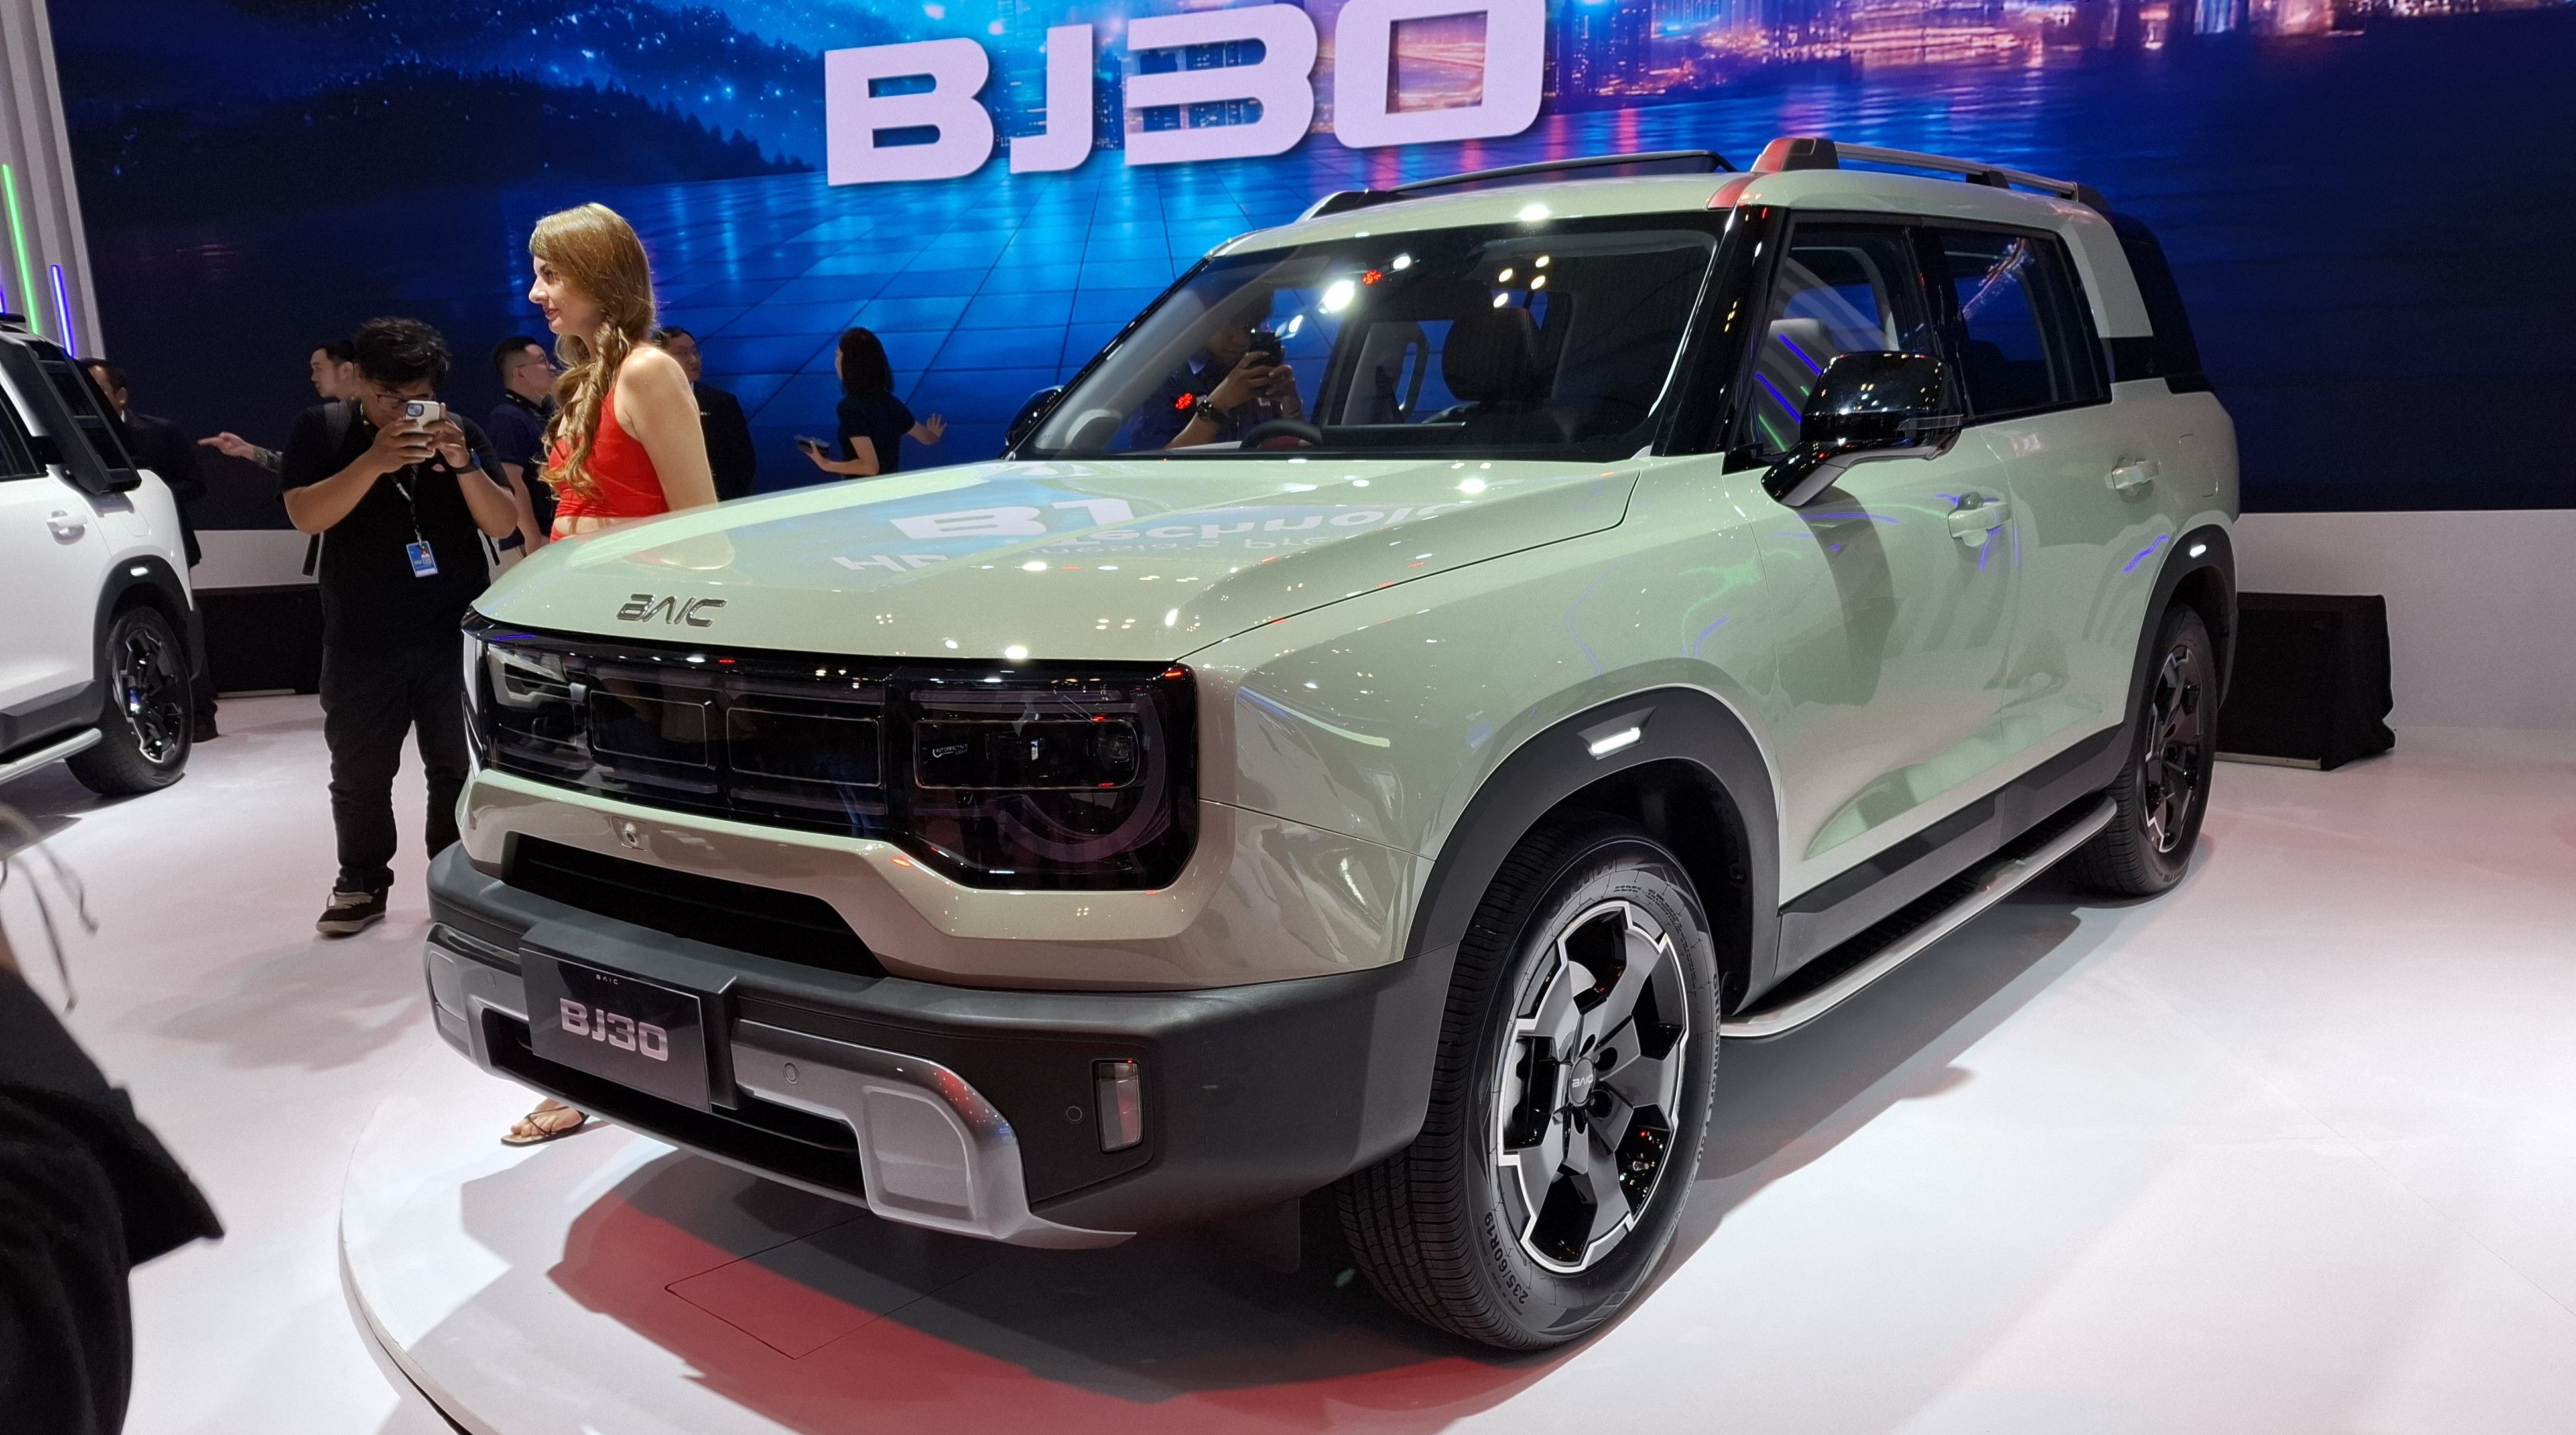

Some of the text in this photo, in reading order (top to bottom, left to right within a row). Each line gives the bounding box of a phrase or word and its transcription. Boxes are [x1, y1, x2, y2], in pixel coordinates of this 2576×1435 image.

[824, 0, 1547, 186] BJ30
[616, 593, 728, 627] BAIC
[559, 996, 669, 1062] BJ30
[1484, 1211, 1529, 1304] 235/60R19
